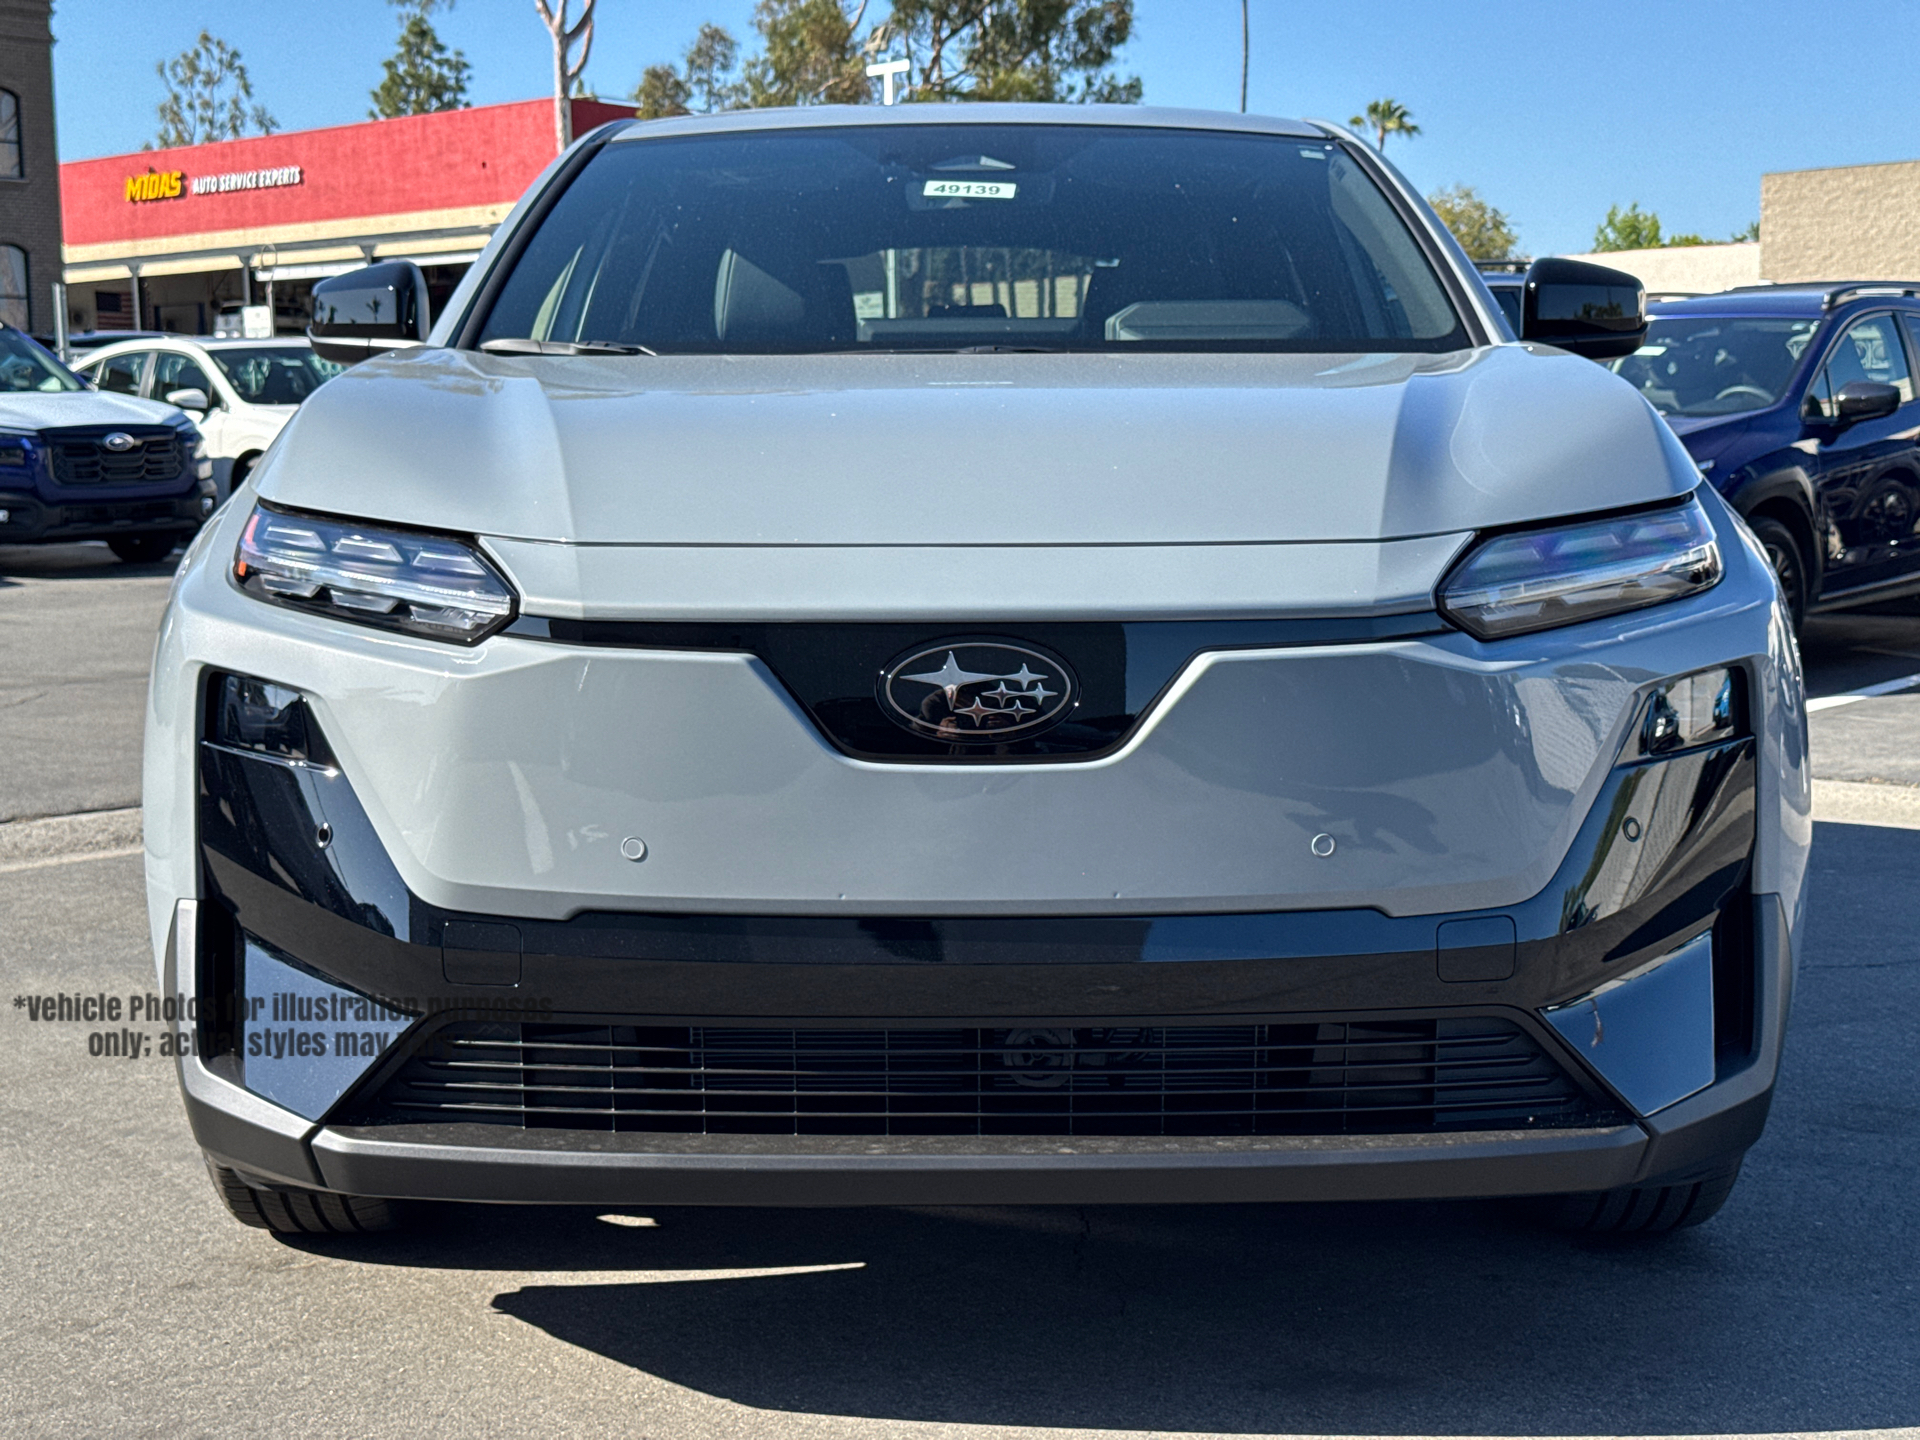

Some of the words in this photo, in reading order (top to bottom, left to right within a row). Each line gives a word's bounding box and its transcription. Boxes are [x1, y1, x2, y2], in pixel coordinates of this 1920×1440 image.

[125, 171, 182, 202] MIDAS
[192, 175, 218, 195] AUTO
[219, 171, 257, 192] SERVICE
[258, 166, 301, 188] EXPERTS
[933, 184, 1001, 195] 49139
